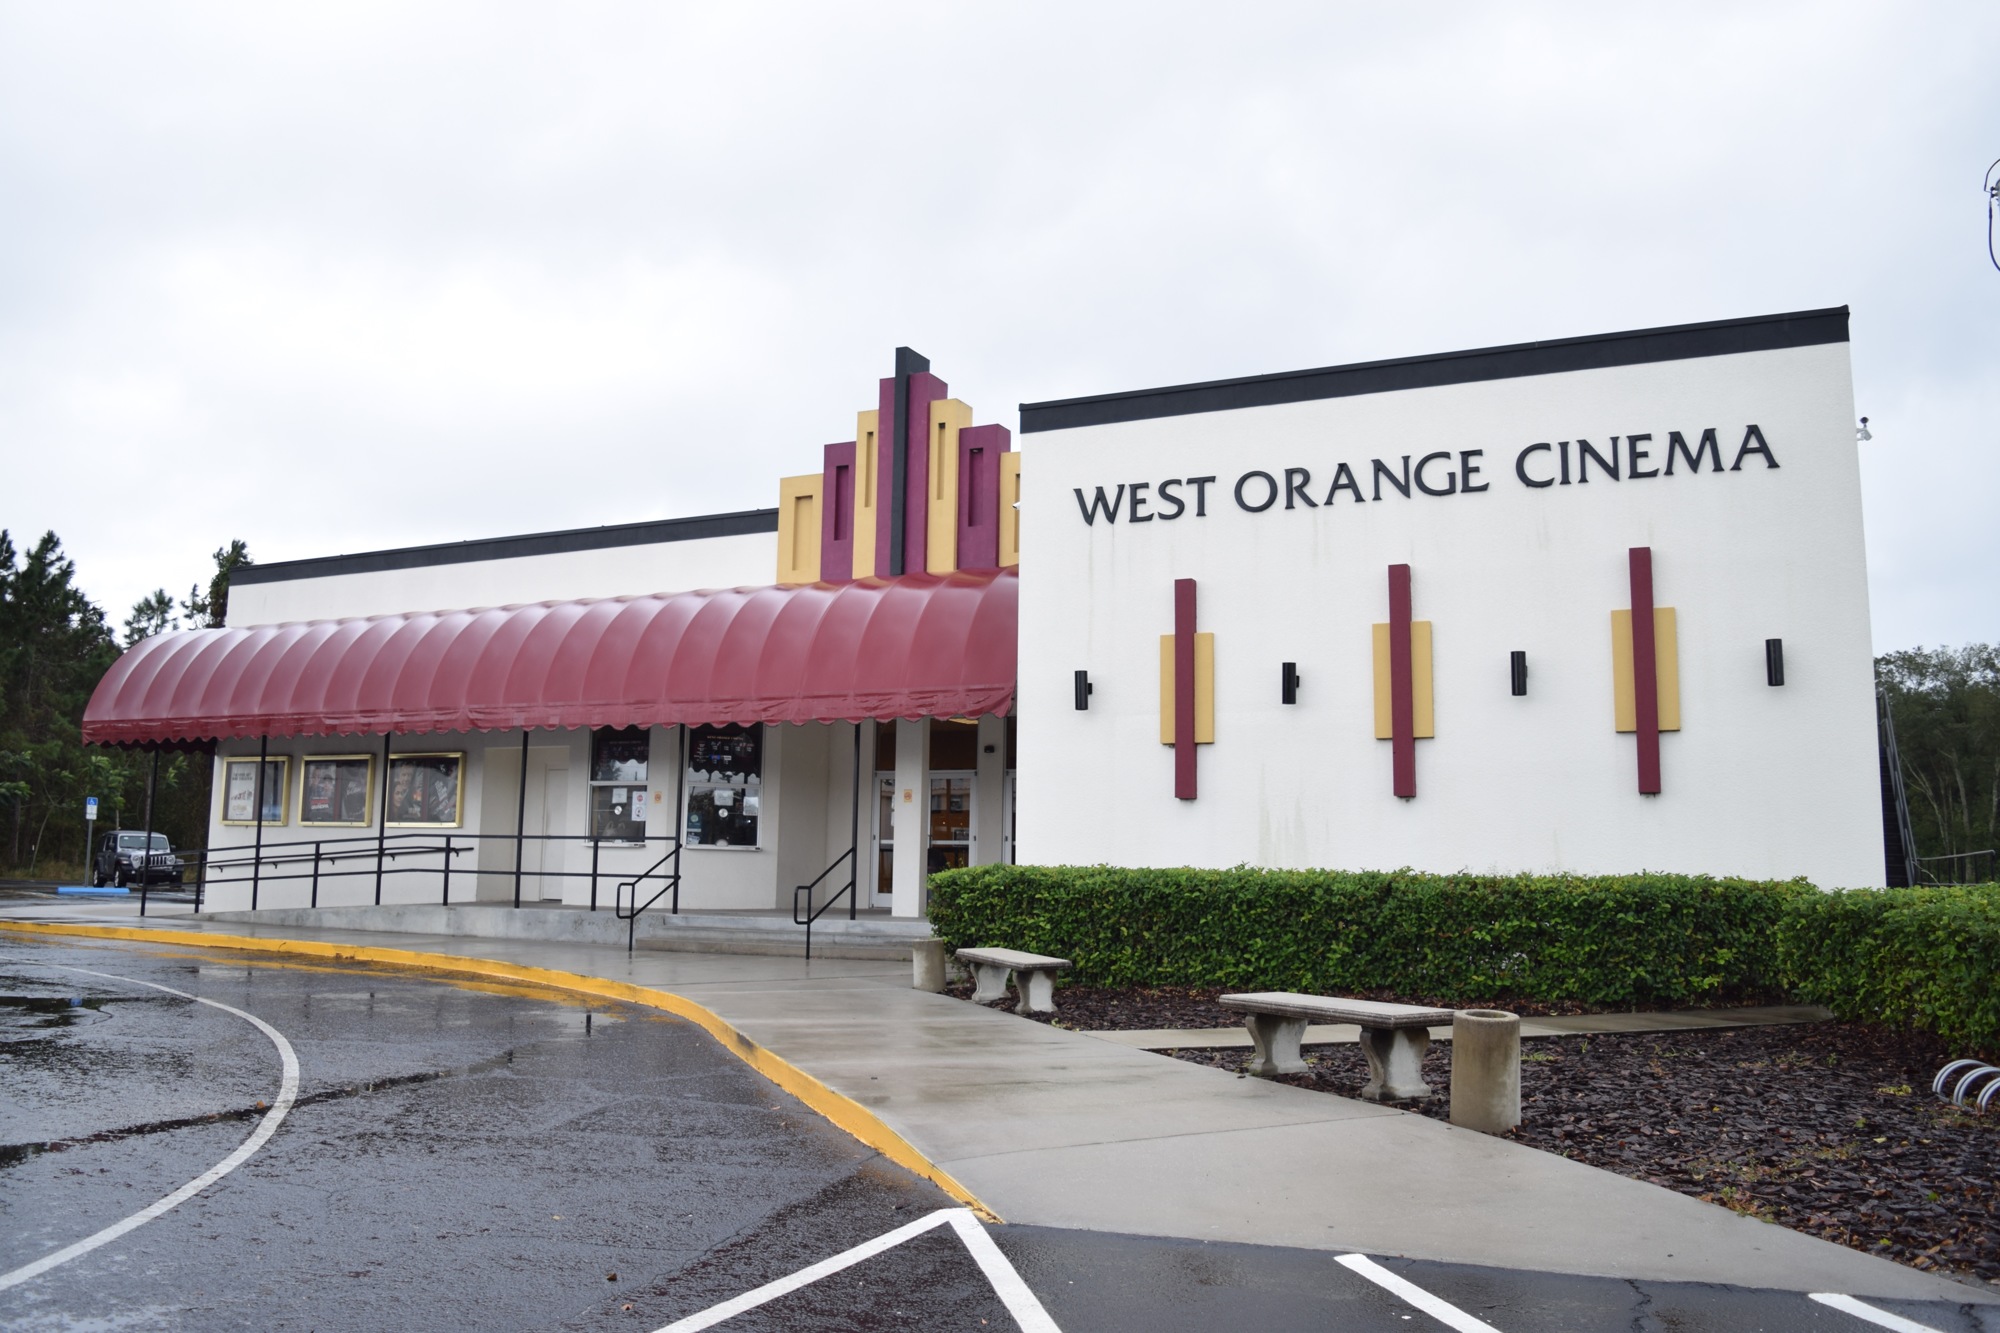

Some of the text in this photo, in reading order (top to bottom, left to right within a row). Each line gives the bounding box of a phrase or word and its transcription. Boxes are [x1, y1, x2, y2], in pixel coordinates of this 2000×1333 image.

[1073, 424, 1781, 527] WEST ORANGE CINEMA
